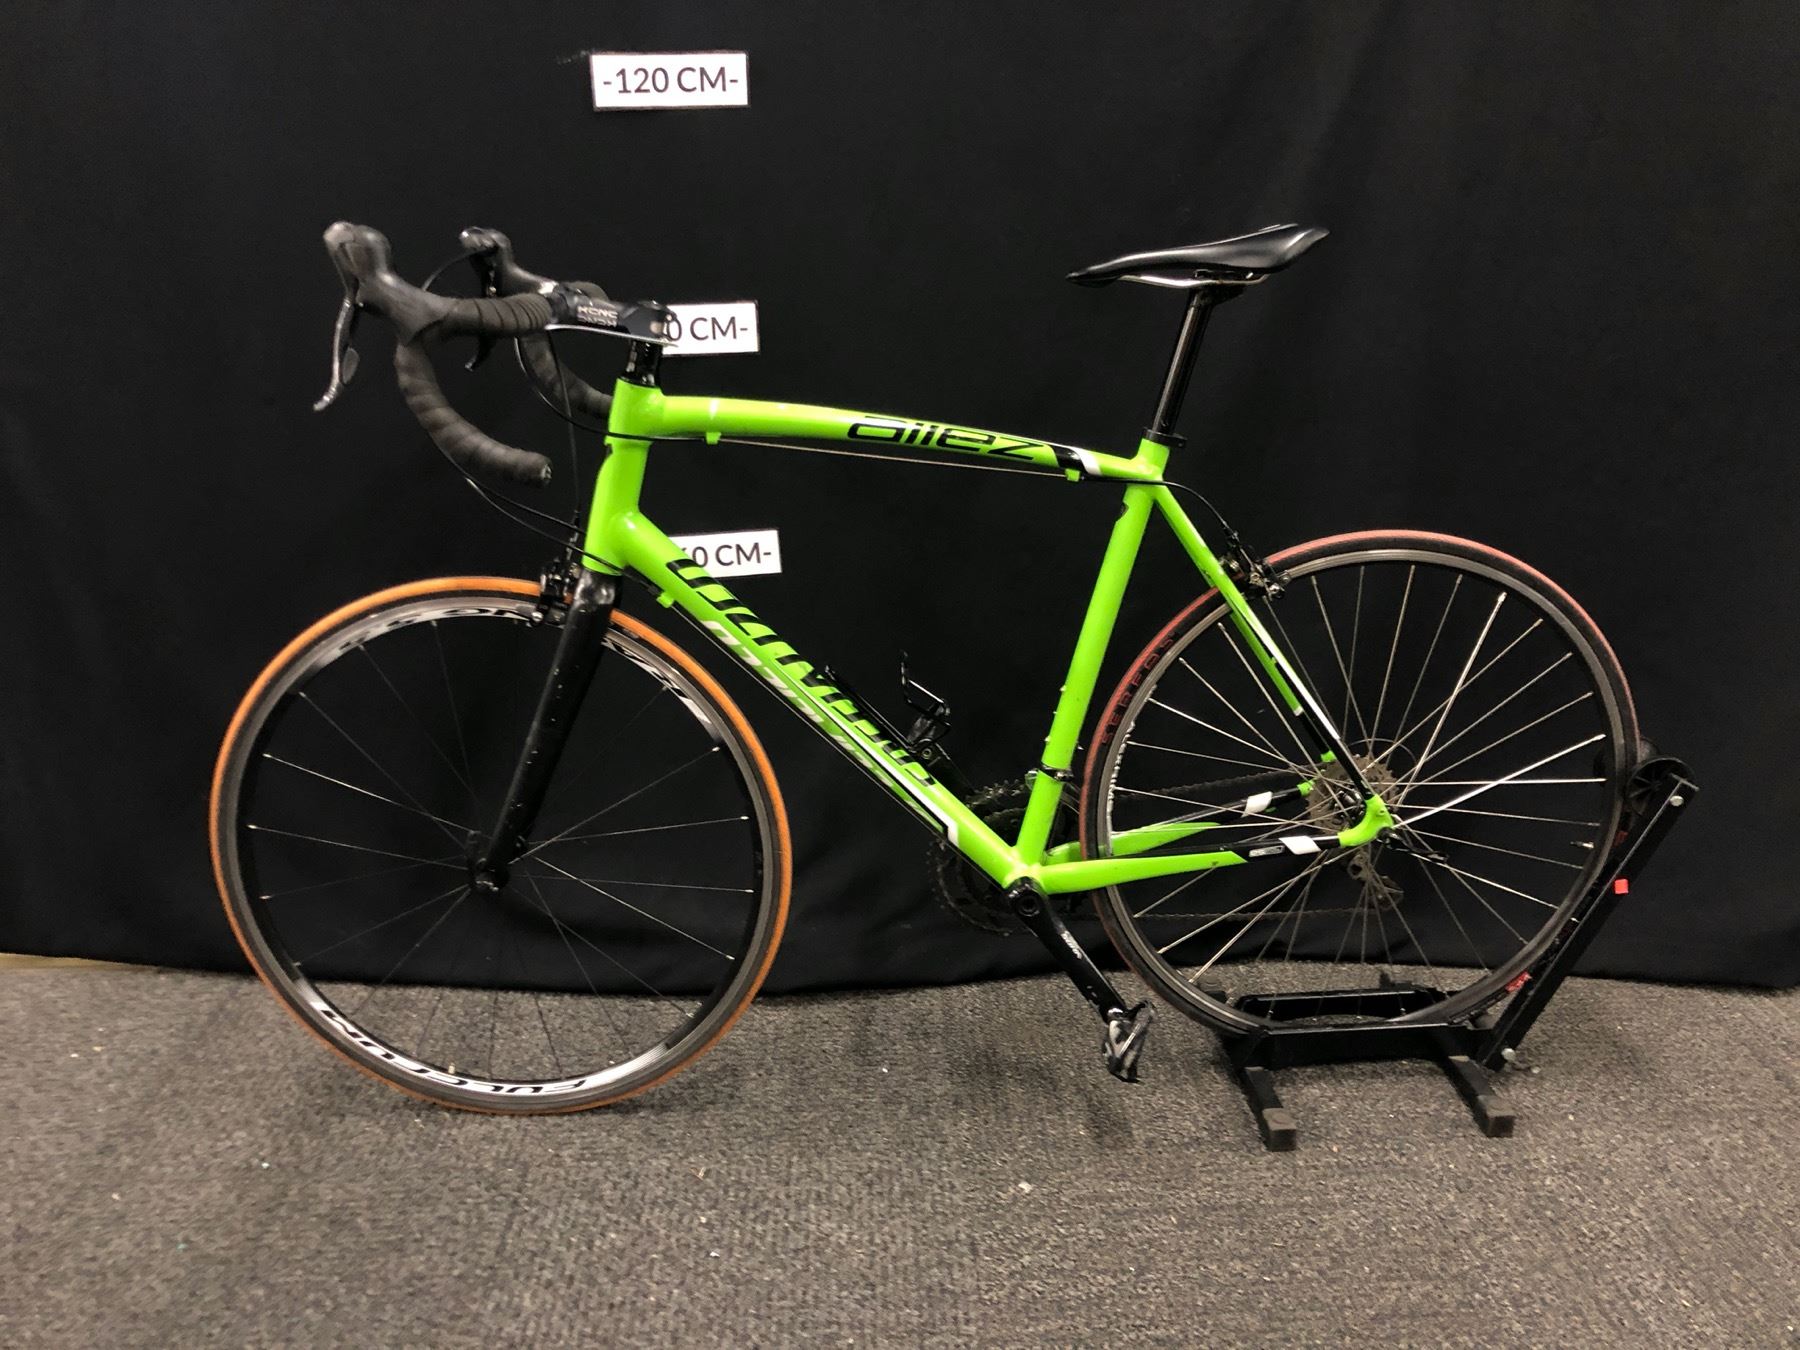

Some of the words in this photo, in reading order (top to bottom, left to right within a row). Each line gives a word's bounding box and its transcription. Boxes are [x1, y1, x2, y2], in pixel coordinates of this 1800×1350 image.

[603, 67, 669, 93] -120
[676, 66, 739, 92] CM-
[689, 315, 748, 341] CM-
[715, 542, 772, 567] CM-
[320, 1008, 588, 1095] FULCRUM
